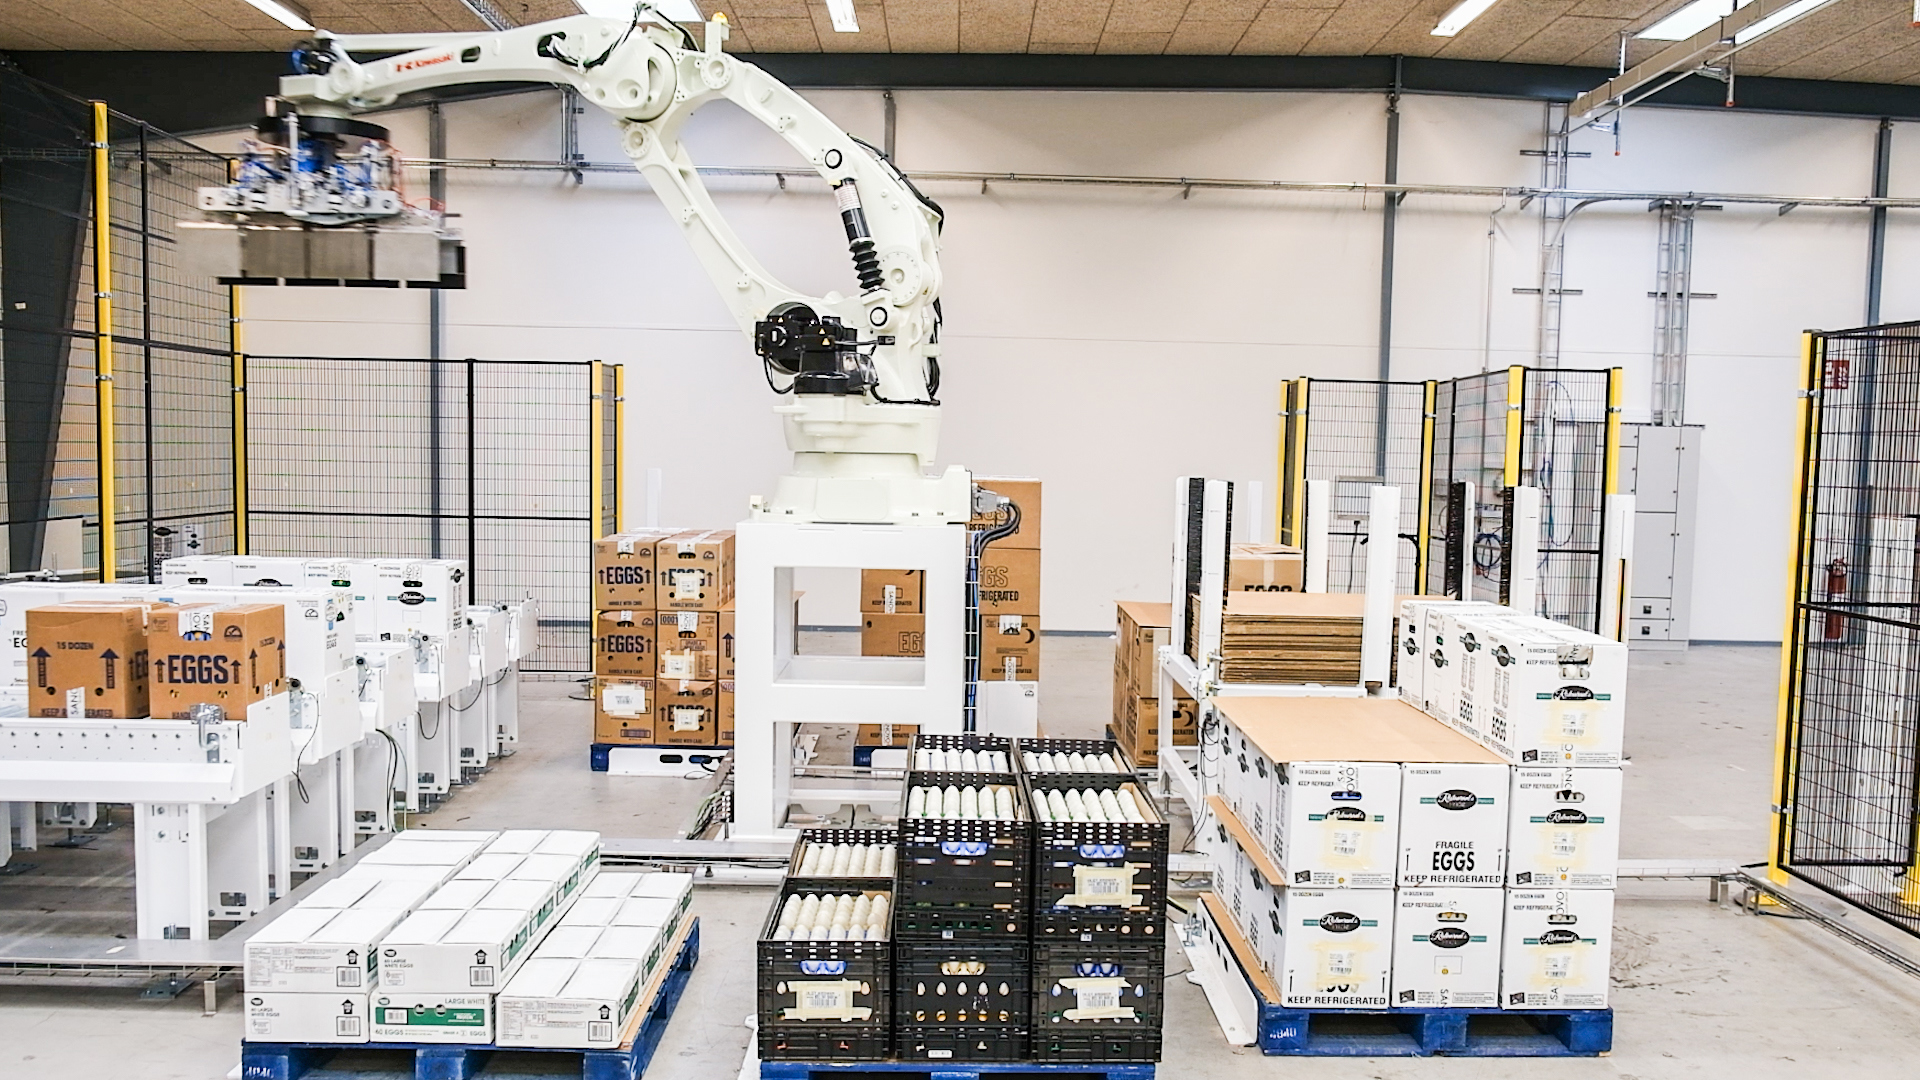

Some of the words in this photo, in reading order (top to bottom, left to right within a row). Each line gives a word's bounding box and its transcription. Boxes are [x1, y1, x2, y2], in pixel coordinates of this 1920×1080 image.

[606, 566, 644, 584] EGGS
[56, 642, 66, 650] 15
[68, 642, 94, 650] DOZEN
[608, 635, 644, 653] EGGS
[899, 632, 925, 653] EG
[168, 655, 229, 684] EGGS
[1433, 852, 1474, 871] EGGS
[1288, 996, 1312, 1004] KEEP
[1314, 996, 1386, 1005] REFRIGERATED
